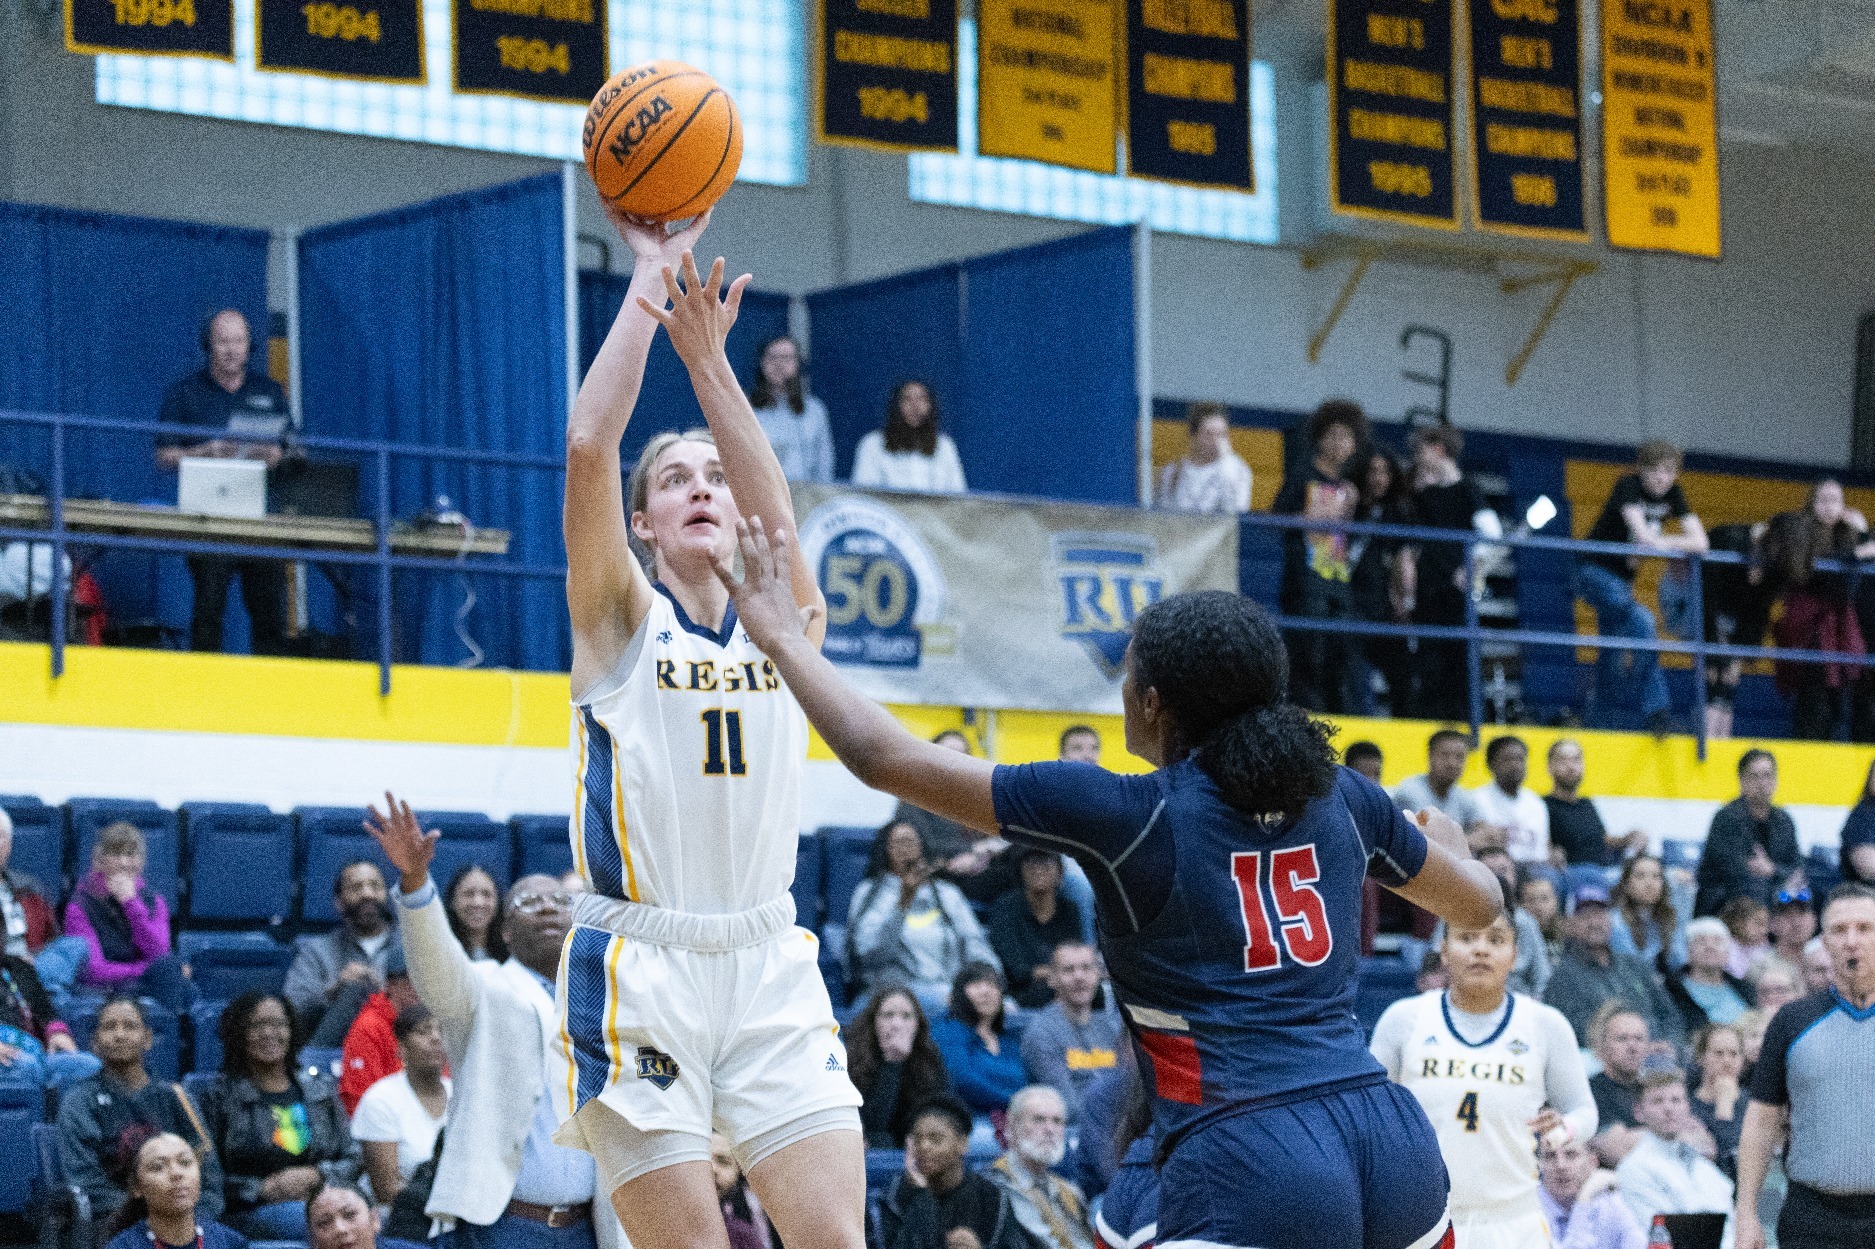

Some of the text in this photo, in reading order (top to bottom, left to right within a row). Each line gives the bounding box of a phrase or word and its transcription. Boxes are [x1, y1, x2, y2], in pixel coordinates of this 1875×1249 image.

[302, 3, 382, 44] 1994
[495, 35, 571, 76] 1994
[609, 95, 673, 167] NCAA
[826, 554, 909, 629] 50
[656, 658, 781, 693] REGIS
[700, 706, 748, 777] 11
[1231, 843, 1333, 973] 15
[1421, 1057, 1525, 1085] REGIS
[1456, 1090, 1480, 1133] 4
